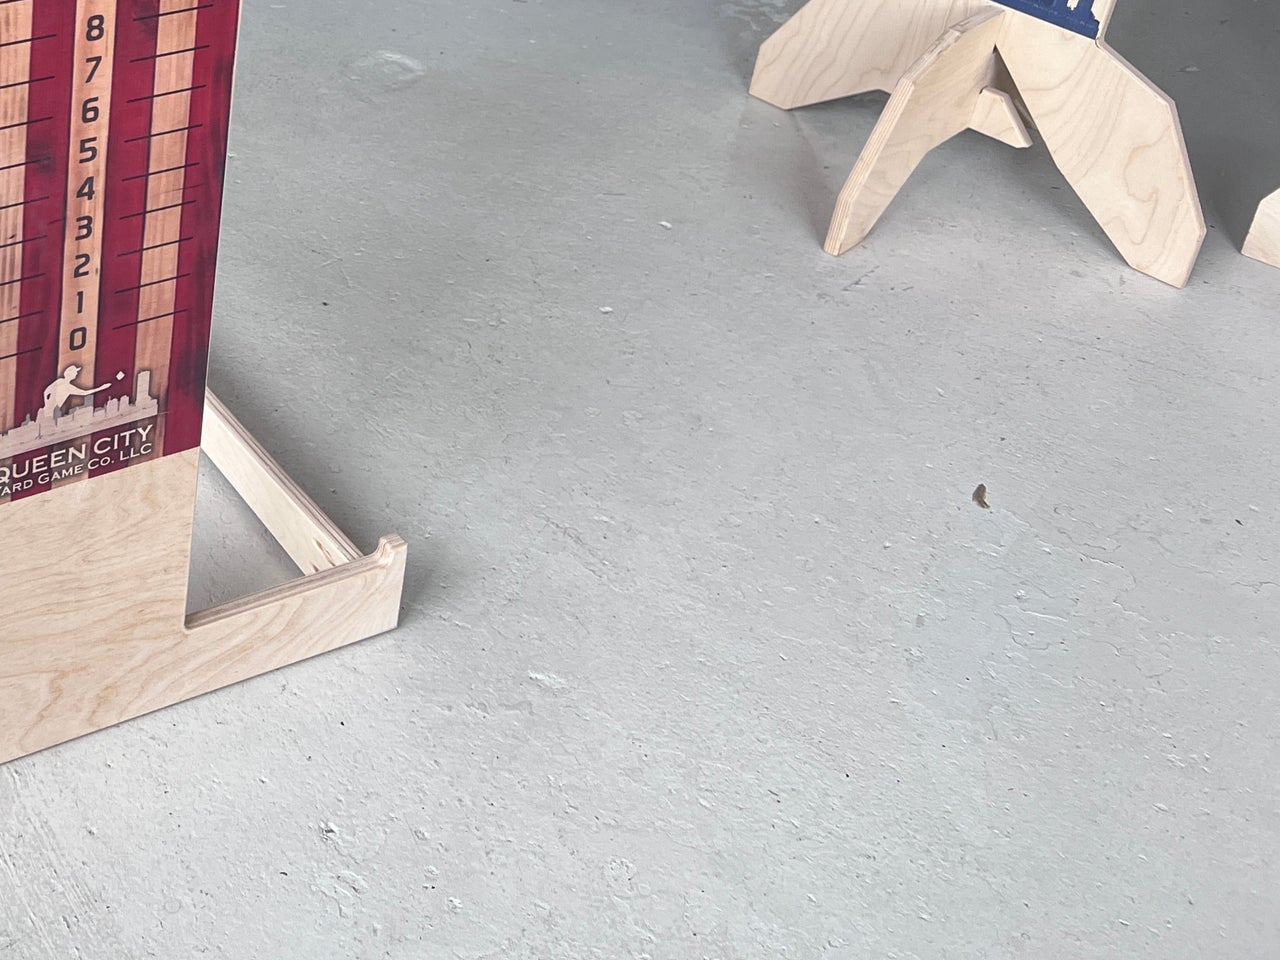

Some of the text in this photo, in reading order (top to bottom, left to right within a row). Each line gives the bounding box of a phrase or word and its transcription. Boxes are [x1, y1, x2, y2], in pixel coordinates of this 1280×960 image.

[86, 14, 104, 41] 8
[85, 56, 102, 83] 7
[81, 96, 99, 123] 6
[79, 137, 97, 163] 5
[76, 176, 95, 200] 4
[75, 215, 92, 240] 3
[73, 253, 90, 278] 2
[77, 291, 83, 314] 1
[69, 327, 87, 351] 0
[93, 424, 153, 455] CITY
[37, 463, 83, 484] GAME
[119, 443, 152, 461] LLC
